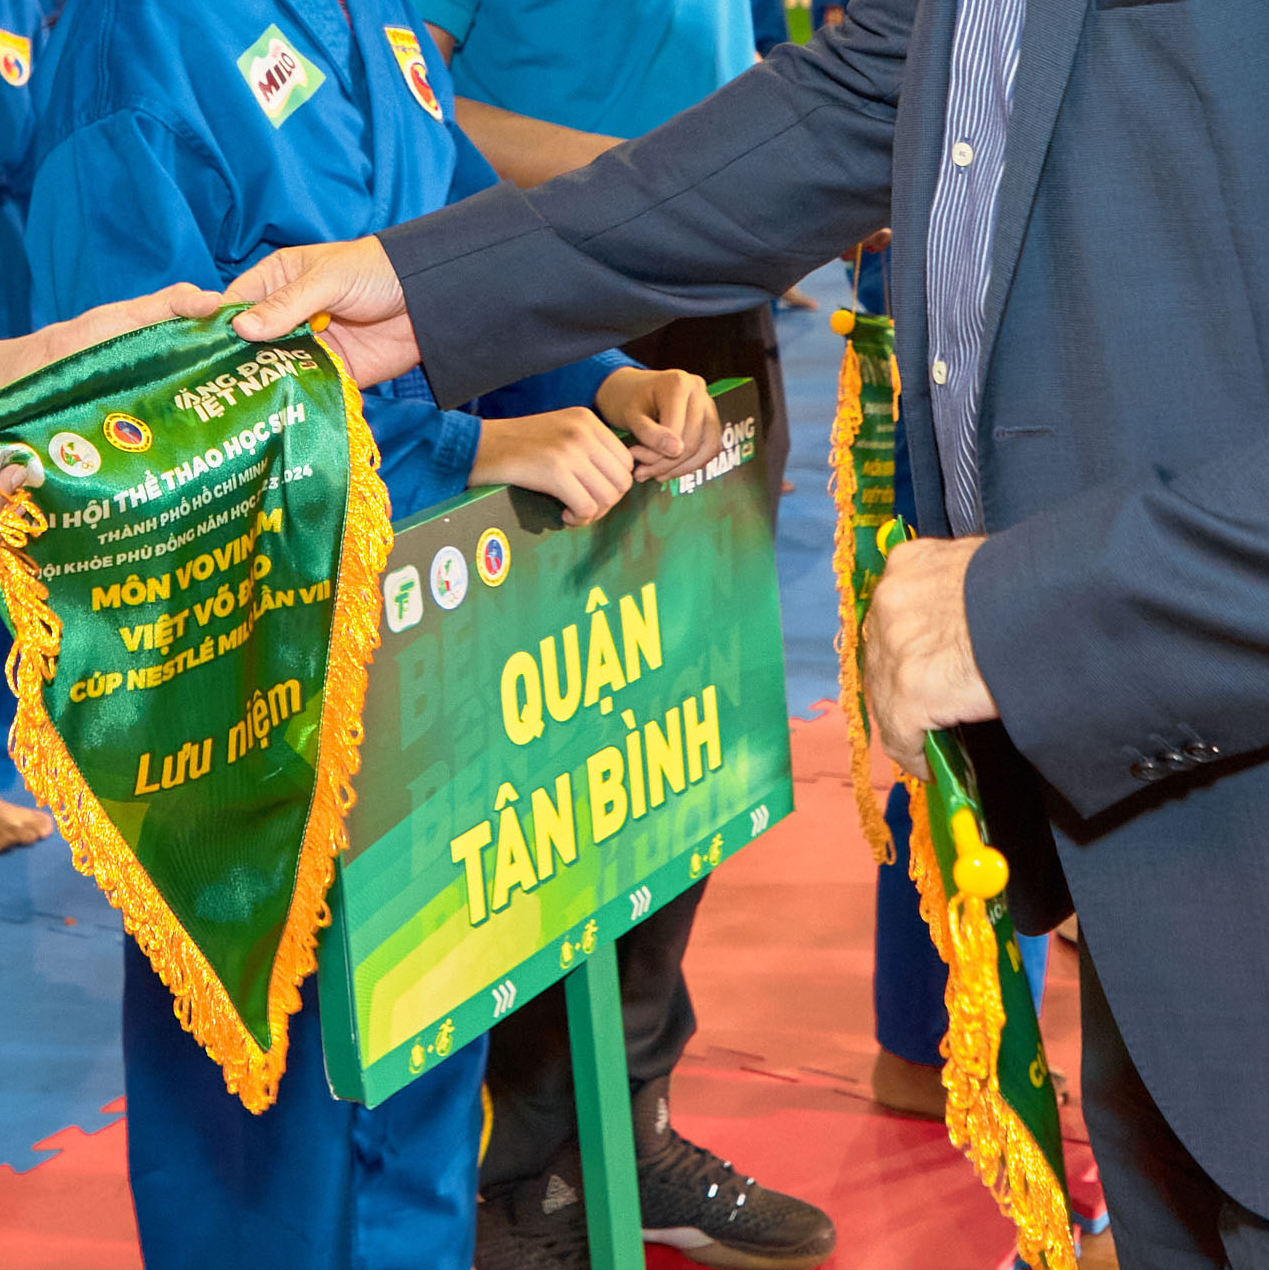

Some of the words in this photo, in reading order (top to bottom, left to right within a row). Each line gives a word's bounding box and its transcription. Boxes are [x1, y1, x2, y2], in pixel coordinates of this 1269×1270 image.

[258, 52, 296, 103] MILO
[237, 360, 299, 397] NAM
[63, 499, 110, 530] HỘI
[161, 448, 224, 490] THAO
[223, 421, 270, 460] HỌC
[706, 444, 741, 481] NAM
[98, 517, 158, 545] THÀNH
[91, 574, 171, 611] MÔN
[119, 610, 189, 655] VIỆT
[193, 583, 235, 626] VÕ
[69, 667, 123, 703] CÚP
[126, 635, 214, 691] NESTLÉ
[500, 582, 663, 746] QUẬN
[134, 736, 213, 797] Lưu
[227, 678, 301, 765] niệm
[450, 773, 578, 925] TÂN
[586, 685, 722, 844] BÌNH
